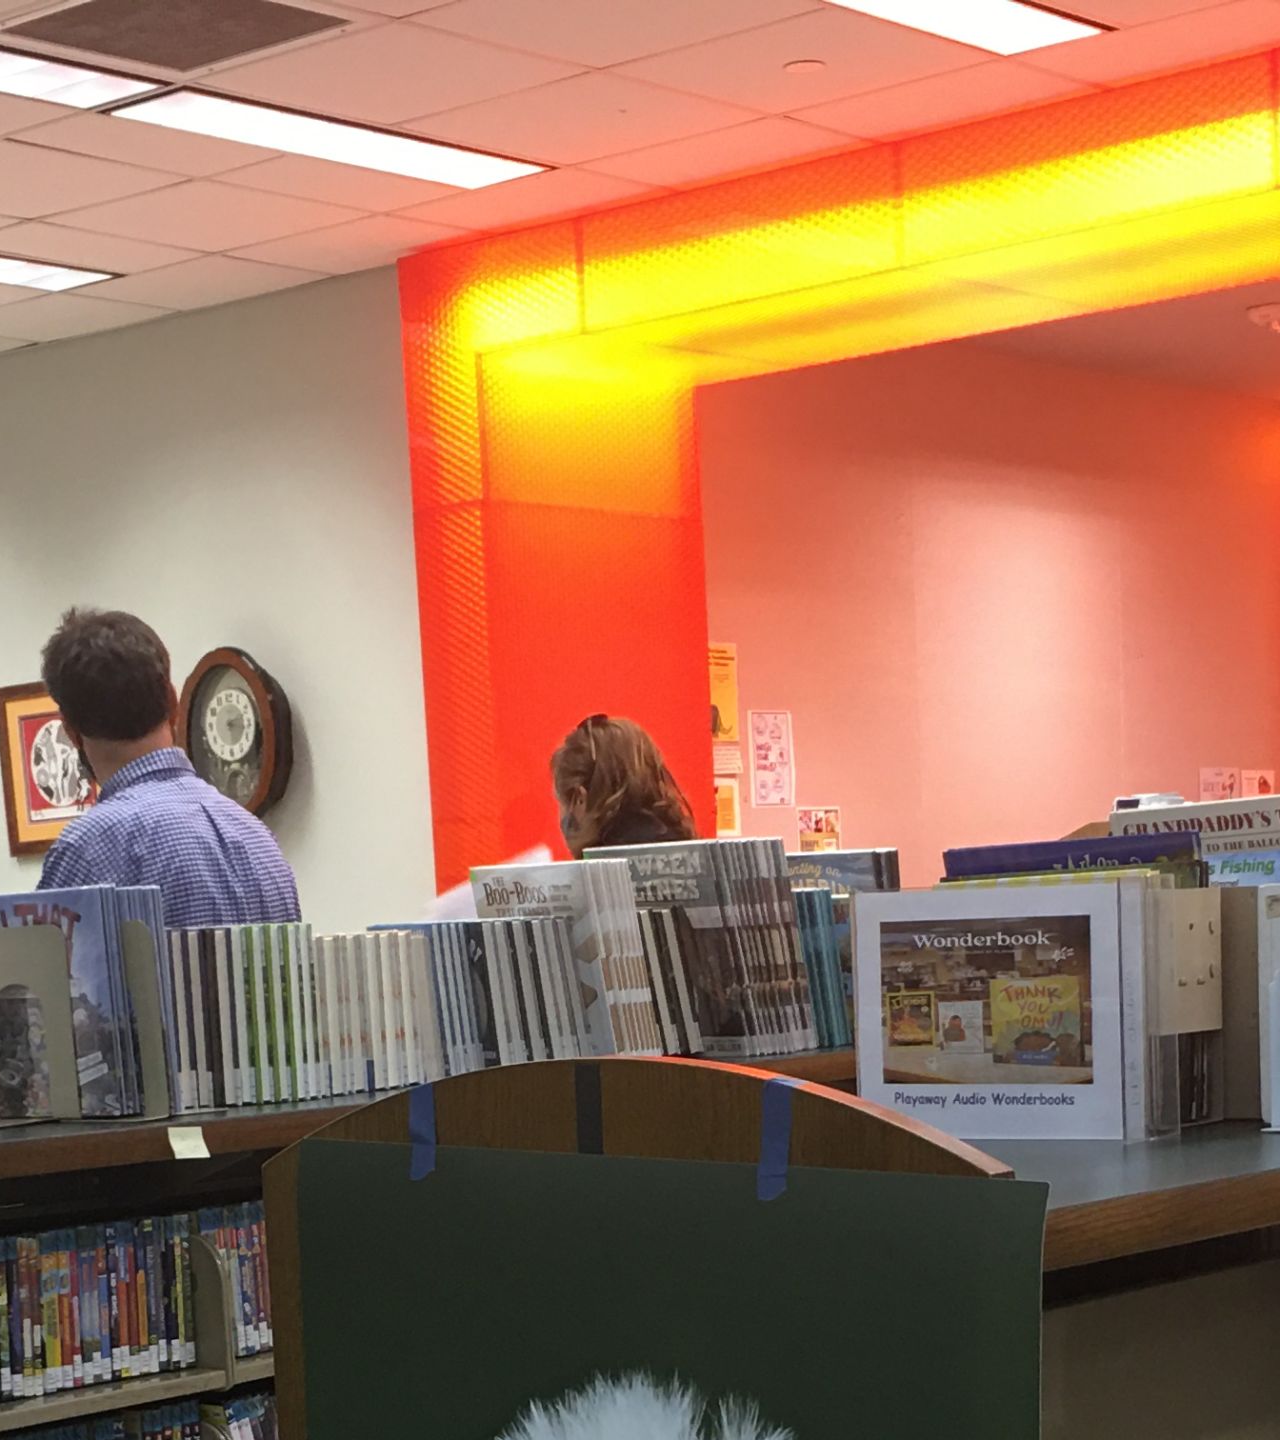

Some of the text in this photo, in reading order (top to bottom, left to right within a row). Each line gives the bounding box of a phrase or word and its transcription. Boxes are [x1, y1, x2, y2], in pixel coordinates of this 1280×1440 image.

[1223, 839, 1246, 851] THE
[1219, 859, 1276, 877] Fishing
[913, 930, 1050, 949] Wonderbook
[999, 984, 1062, 1003] THANK
[1018, 1002, 1051, 1015] YOU
[894, 1091, 1075, 1108] Playaway Audio Wonderbooks
